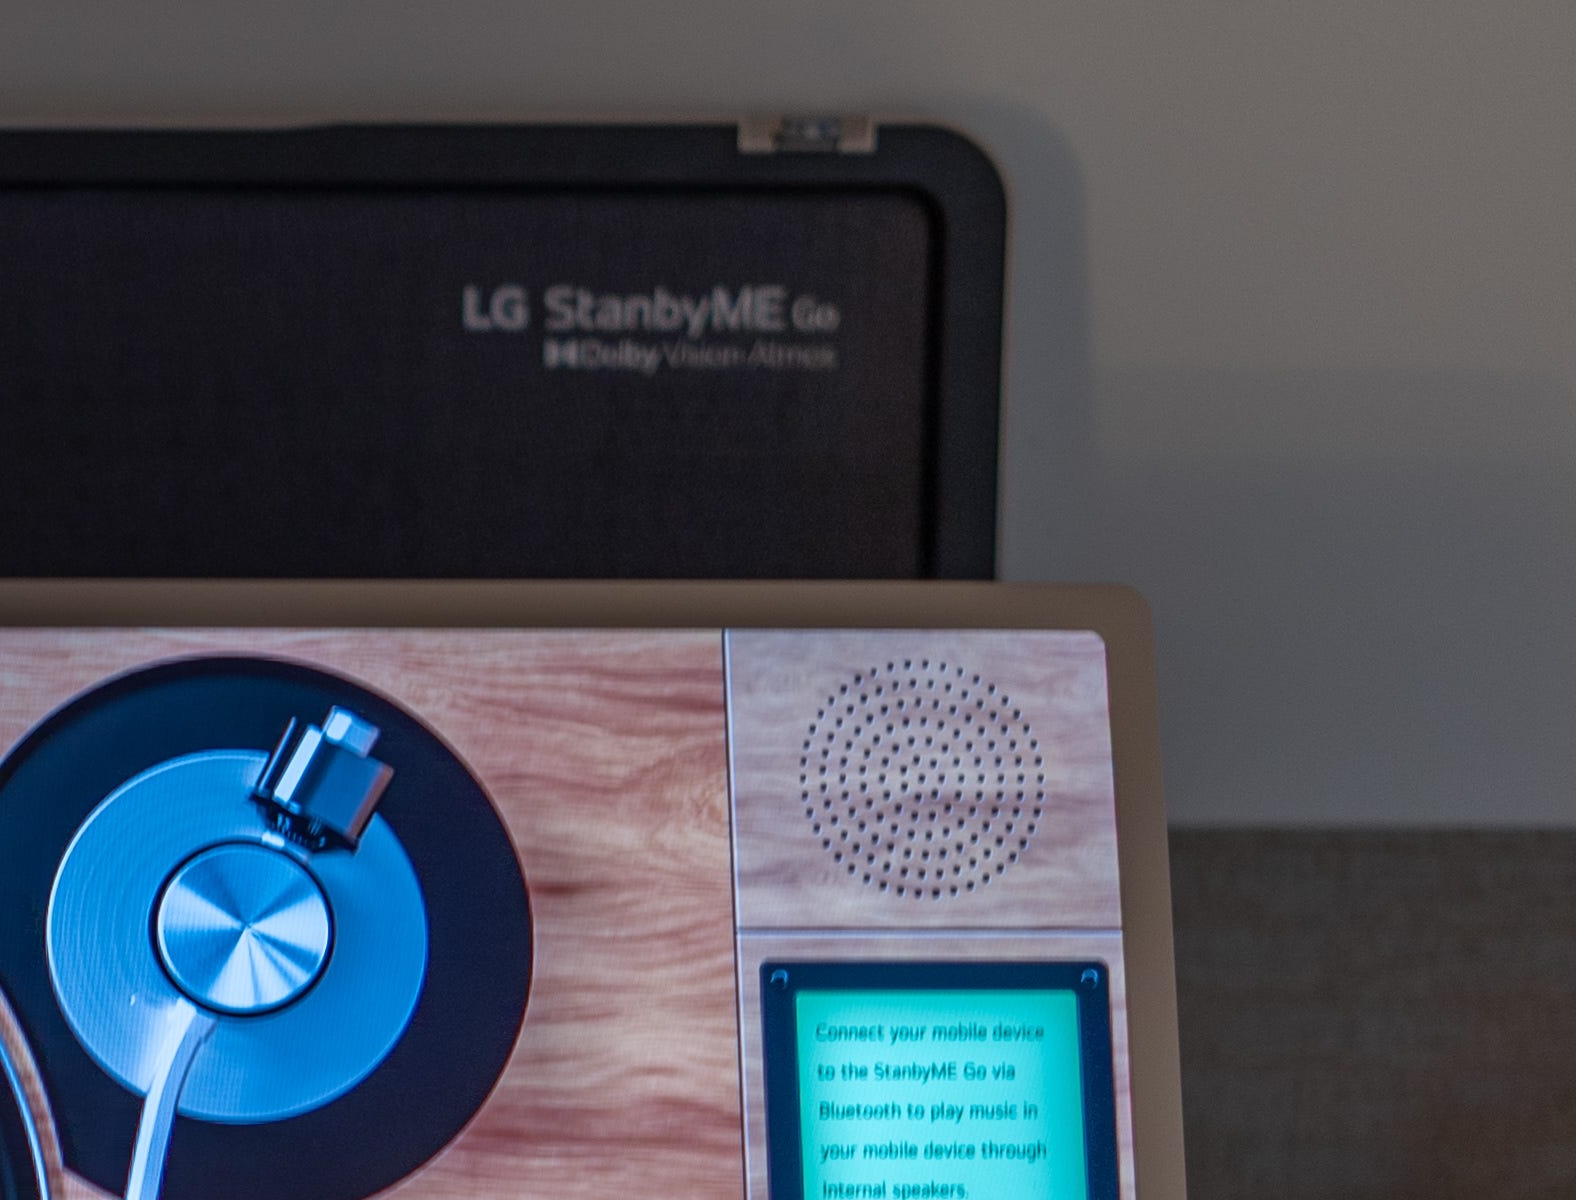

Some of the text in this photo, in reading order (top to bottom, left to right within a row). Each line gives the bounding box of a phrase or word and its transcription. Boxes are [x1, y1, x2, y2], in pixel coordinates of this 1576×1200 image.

[462, 284, 840, 339] LG StanbyME Go
[816, 1022, 1044, 1045] Connect your mobile device
[817, 1062, 1015, 1085] to the StanbyME Go via
[819, 1101, 1038, 1124] Bluetooth to play music in
[820, 1140, 1046, 1164] your mobile device through
